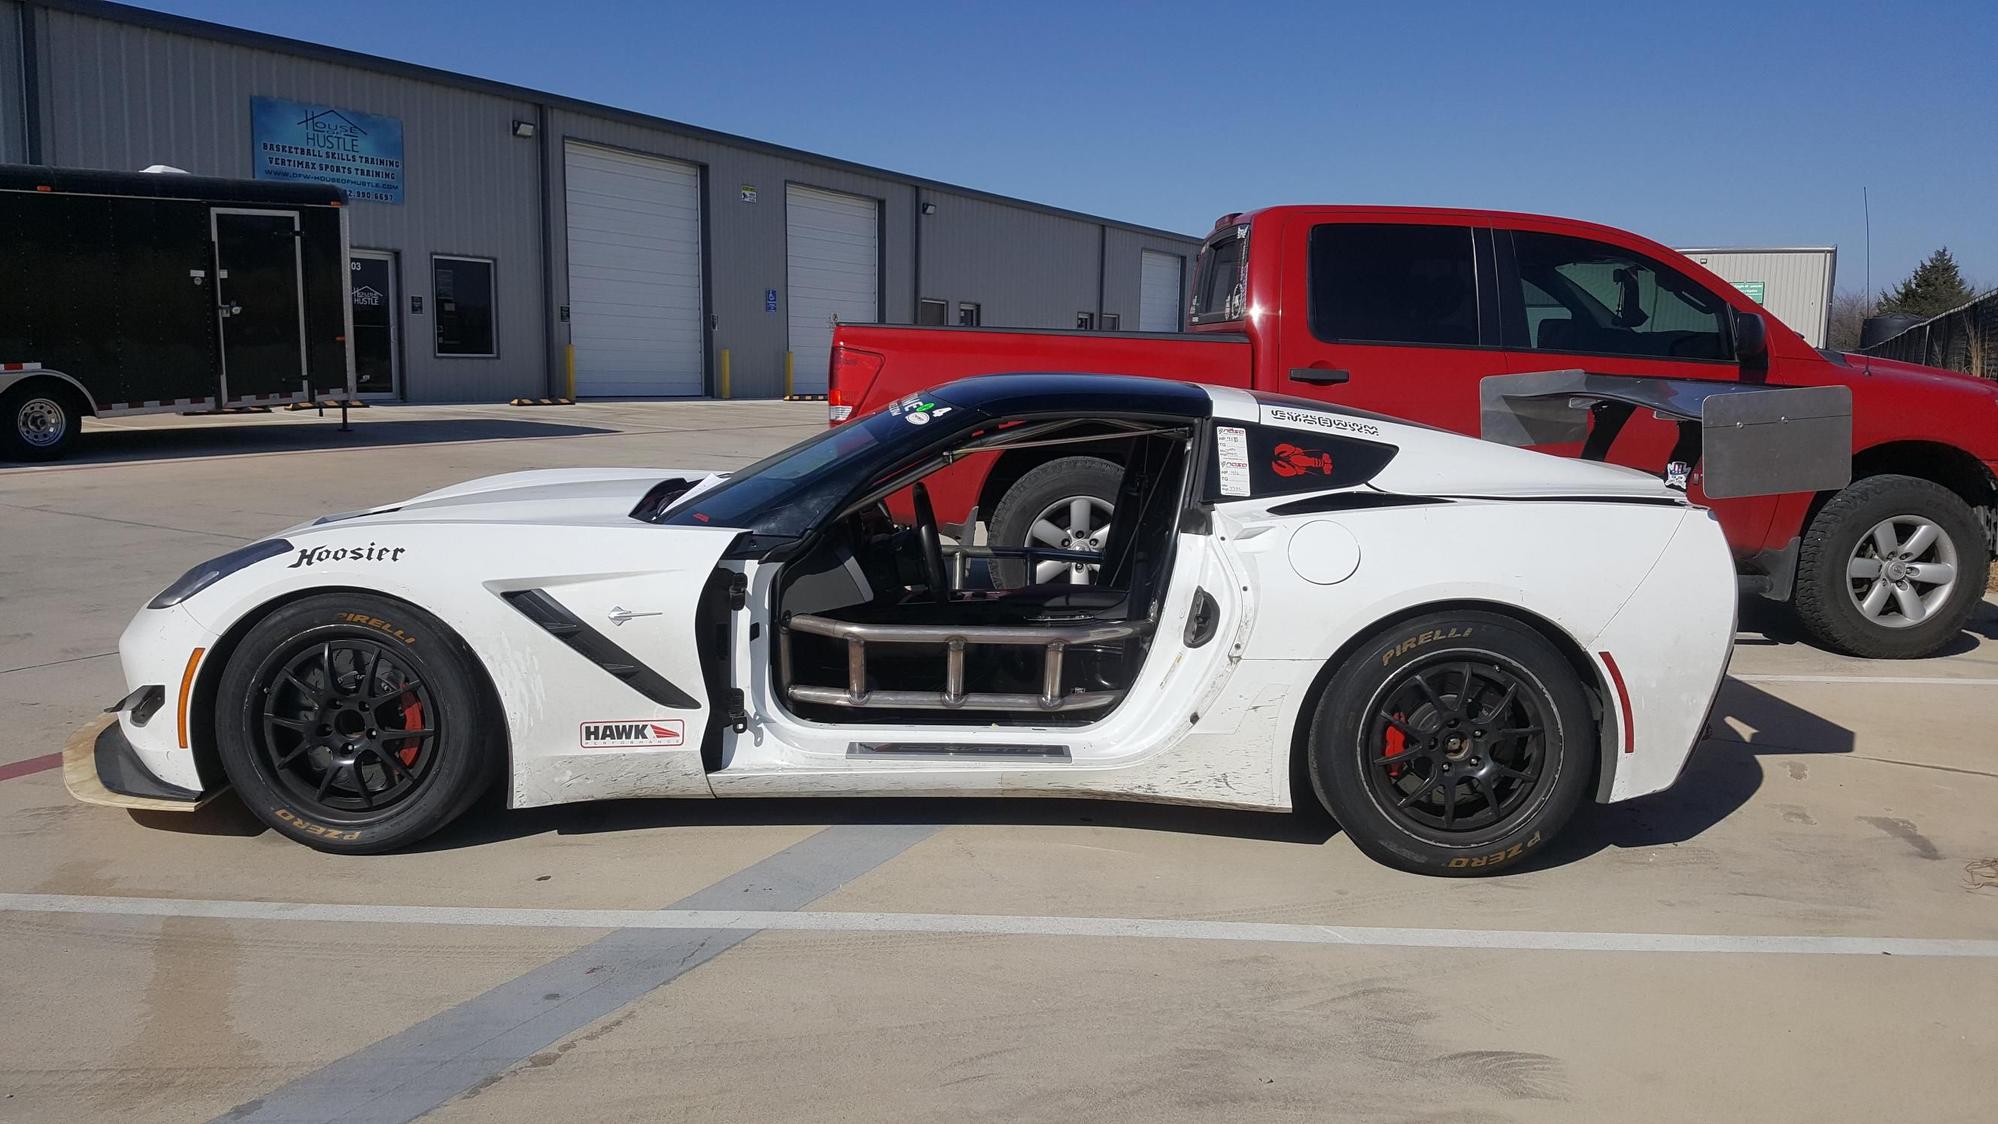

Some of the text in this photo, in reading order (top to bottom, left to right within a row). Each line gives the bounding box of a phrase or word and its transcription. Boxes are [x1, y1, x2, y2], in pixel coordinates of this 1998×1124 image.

[305, 131, 360, 153] HUSTLE
[262, 142, 400, 168] BASKETBALL SKILLS TRAINING
[268, 156, 396, 180] VERTIMAX SPORTS TRAINING
[354, 297, 380, 306] HUSTLE
[286, 541, 406, 568] Hoosier
[337, 612, 416, 644] PIRELLI
[1382, 627, 1473, 666] PIRELLI
[585, 724, 649, 741] HAWK
